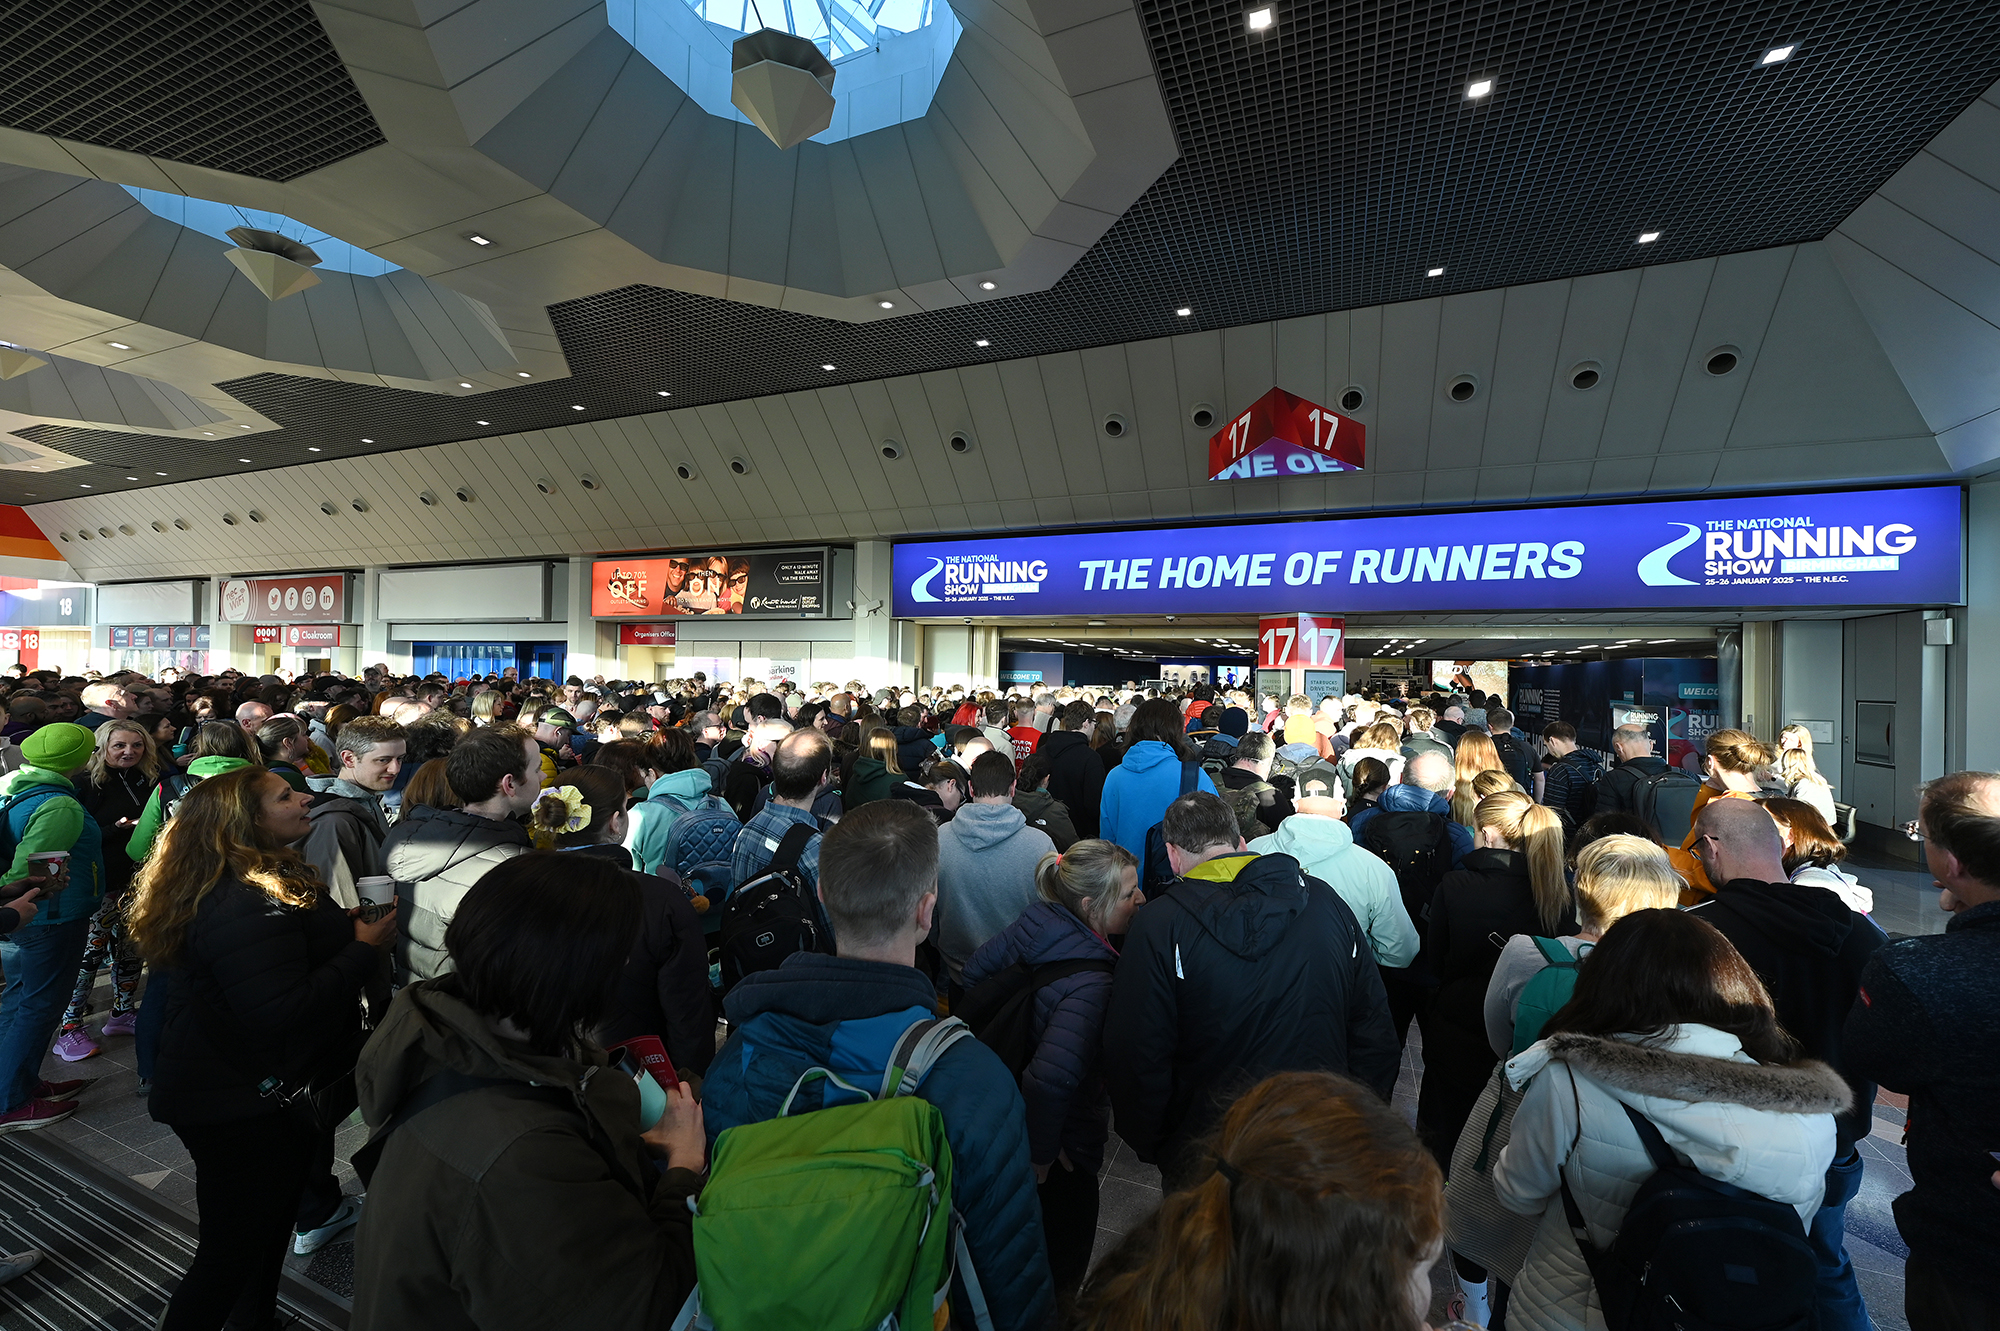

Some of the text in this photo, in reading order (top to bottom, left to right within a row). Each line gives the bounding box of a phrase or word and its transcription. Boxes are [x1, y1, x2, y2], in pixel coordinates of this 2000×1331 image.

[1228, 411, 1251, 458] 17
[1308, 408, 1338, 450] 17
[1706, 516, 1814, 531] THE NATIONAL
[1705, 523, 1917, 560] RUNNING
[961, 554, 999, 562] NATIONAL
[1079, 540, 1586, 590] THE HOME OF RUNNERS
[1704, 557, 1896, 576] SHOW BIRMINGHAM
[945, 560, 1048, 584] RUNNING
[611, 580, 647, 598] OFF
[690, 578, 720, 596] ON
[944, 584, 979, 595] SHOW
[1731, 577, 1771, 586] JANUARY
[1772, 577, 1794, 585] 2025
[226, 588, 238, 600] nec
[229, 594, 245, 611] WiFi
[60, 598, 72, 615] 18
[22, 634, 38, 649] 18
[302, 630, 332, 639] Cloakroom
[1262, 627, 1296, 665] 17
[1302, 628, 1341, 666] 17
